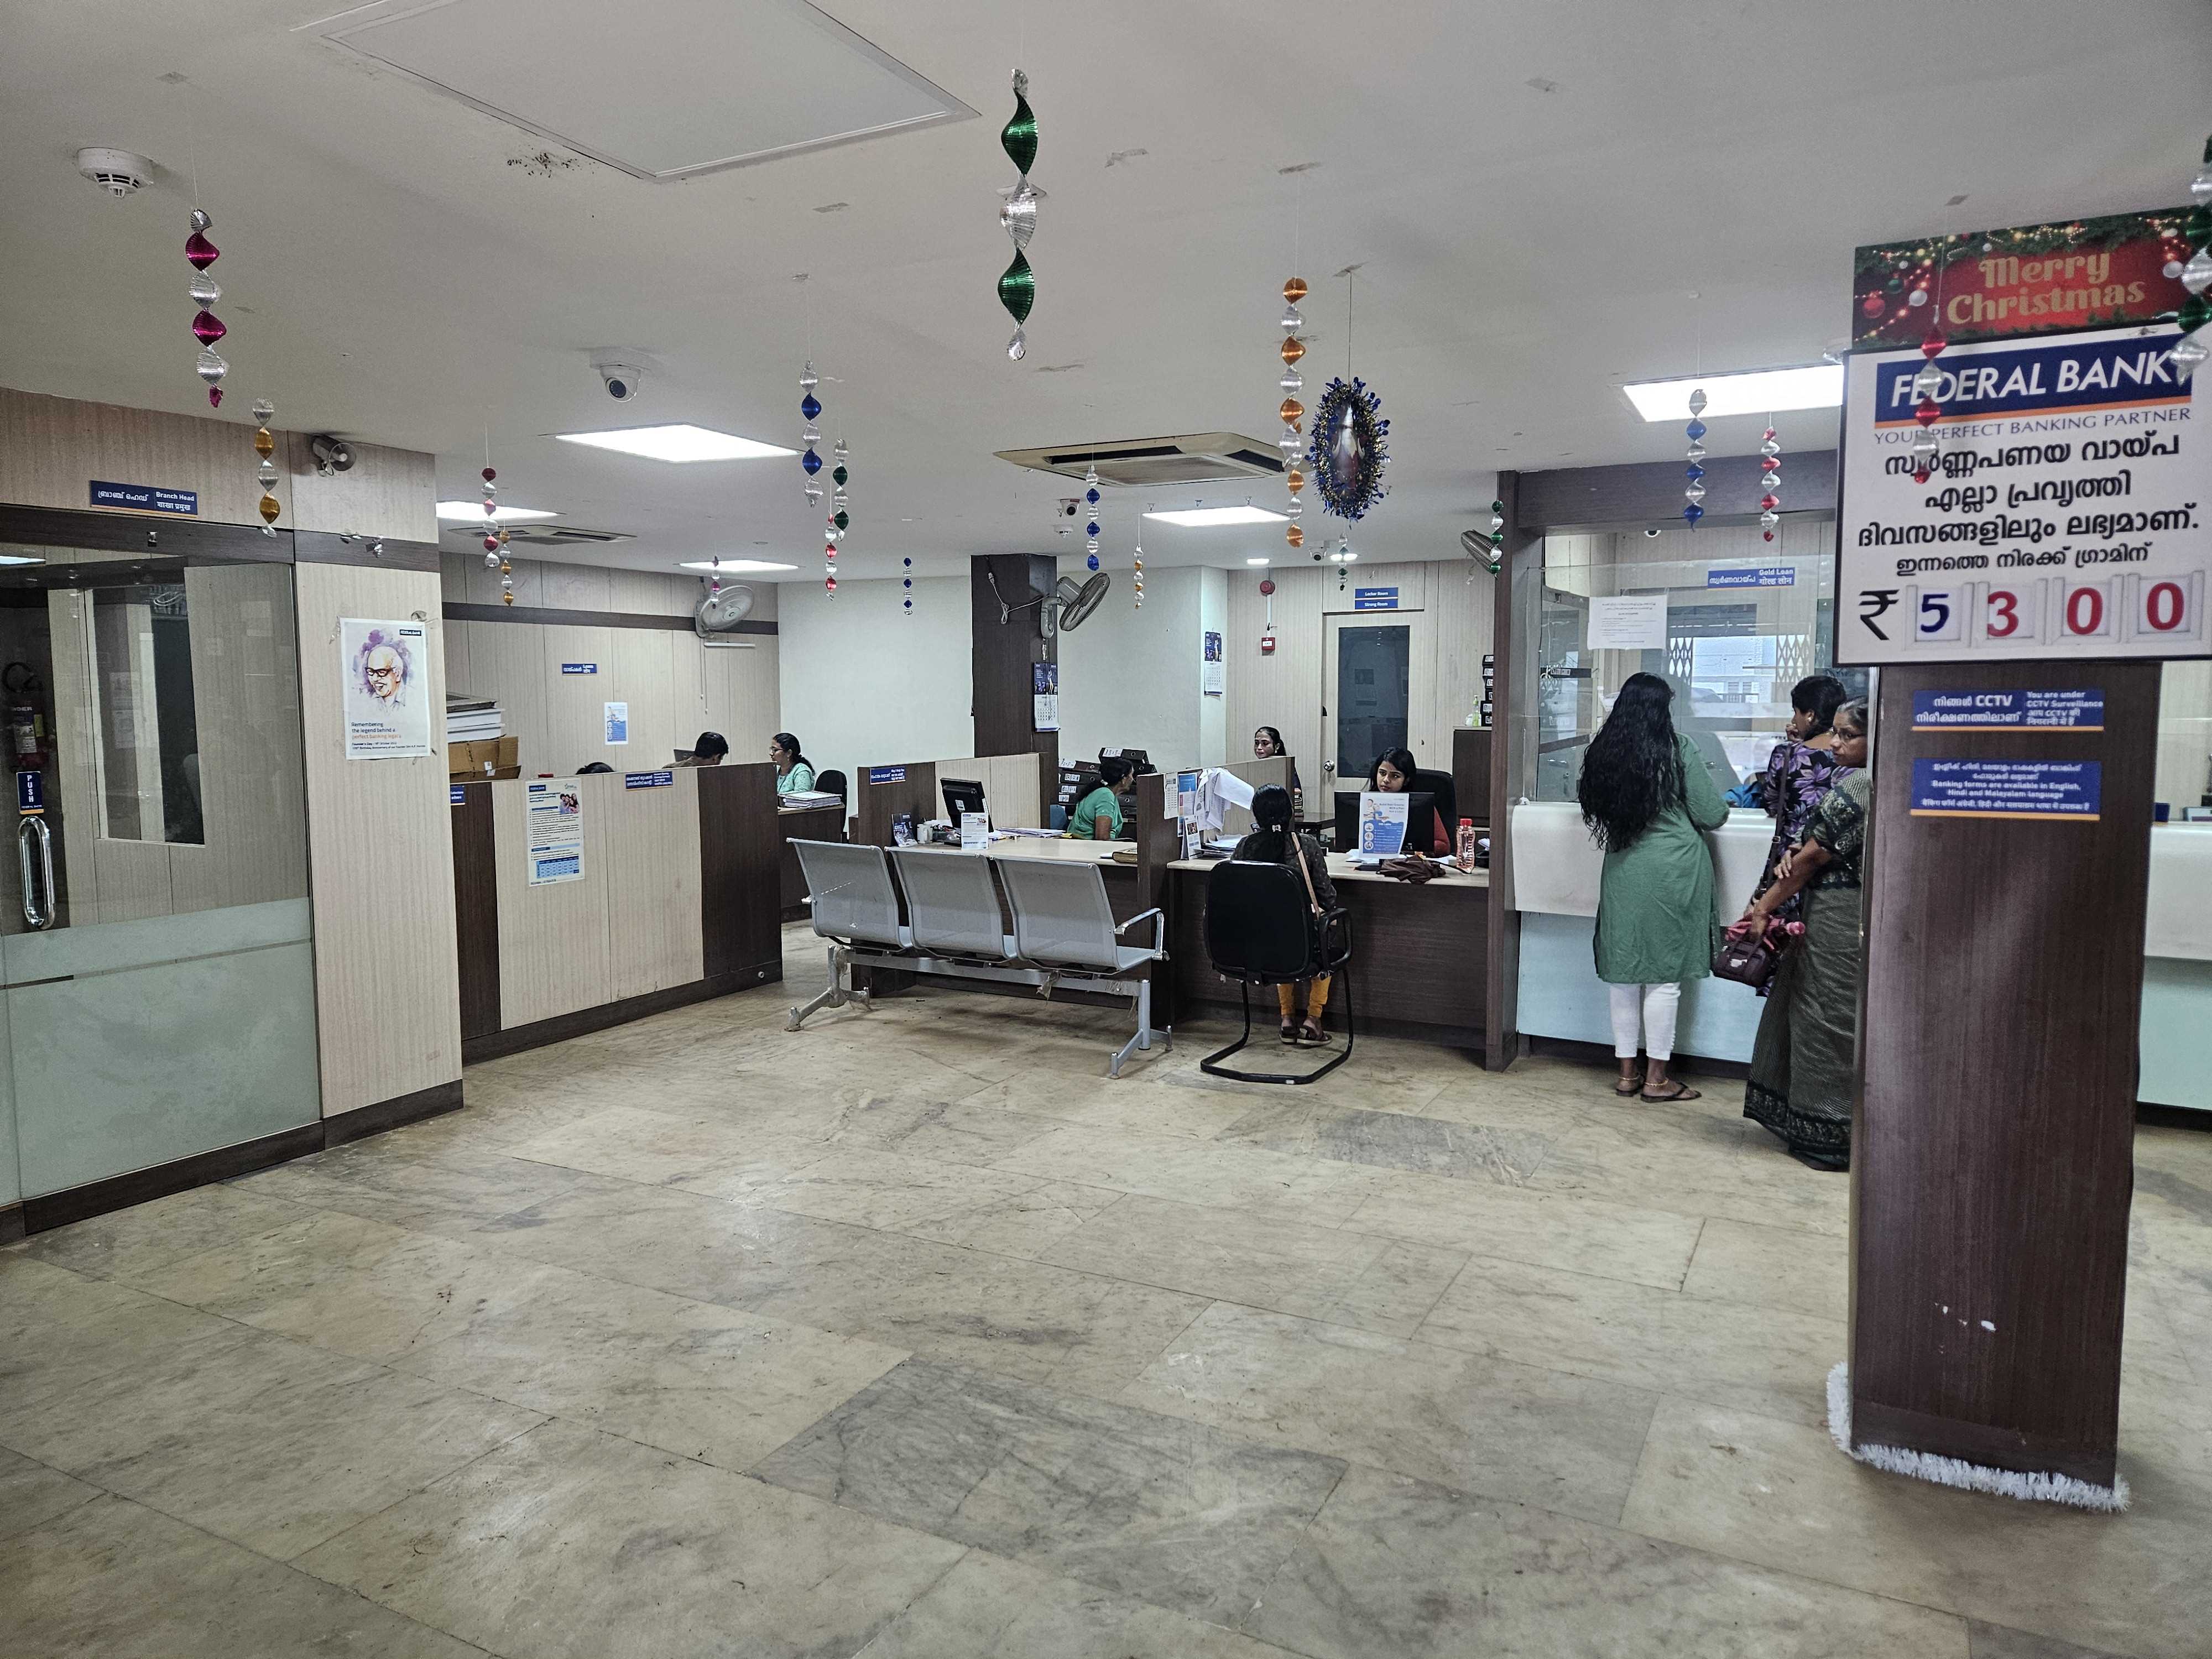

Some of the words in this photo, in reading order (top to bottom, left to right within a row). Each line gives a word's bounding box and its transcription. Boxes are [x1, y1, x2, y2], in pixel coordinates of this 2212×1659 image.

[1979, 253, 2111, 288] Merry
[1947, 281, 2146, 324] Christmas
[2056, 351, 2173, 393] BANK
[1932, 422, 2004, 440] PERFECT
[2010, 415, 2097, 436] BANKING
[2104, 408, 2192, 427] PARTNER
[2081, 430, 2180, 460] വായ്പ
[156, 491, 178, 499] Branch
[1924, 484, 1998, 514] എല്ലാ
[2008, 469, 2132, 508] പ്രവൃത്തി
[1858, 514, 2057, 547] ദിവസങ്ങളിലും
[1896, 552, 1990, 576] ഇന്നത്തെ
[1996, 546, 2071, 568] നിരക്ക്
[2075, 541, 2153, 568] ഗ്രാമിന്
[1975, 694, 2013, 707] CCTV
[1932, 780, 1963, 789] Banking
